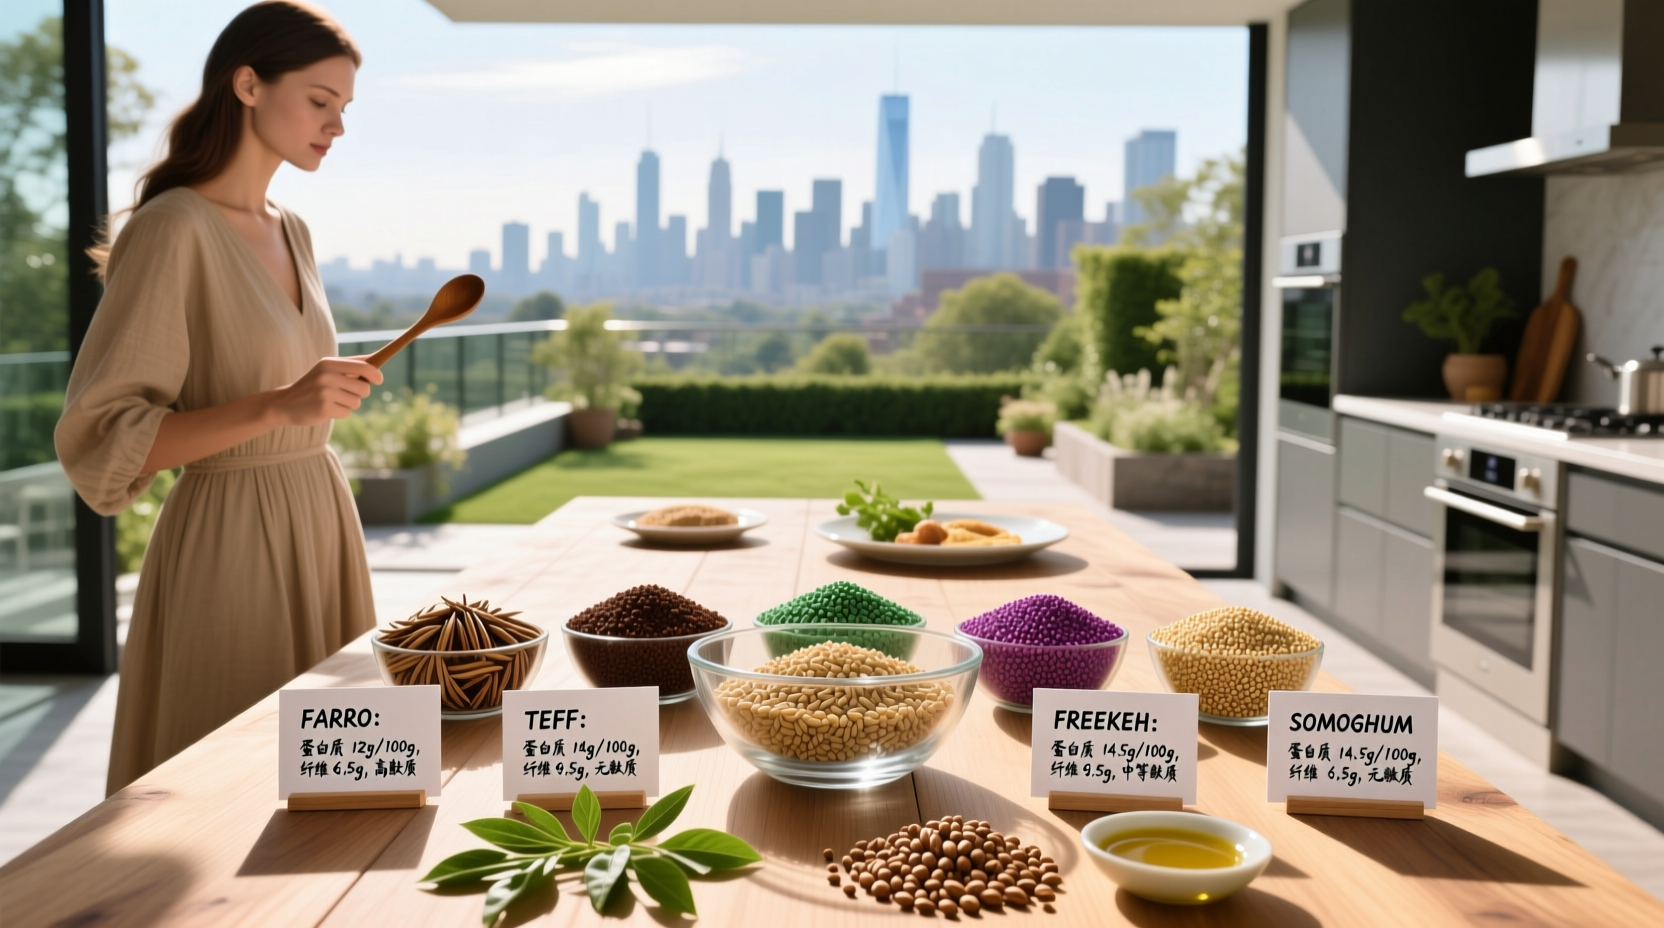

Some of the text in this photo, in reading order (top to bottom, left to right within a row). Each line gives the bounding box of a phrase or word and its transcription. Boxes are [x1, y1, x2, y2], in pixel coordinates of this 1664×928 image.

[301, 708, 380, 729] FARRO:
[525, 709, 586, 730] TEFF:
[1054, 710, 1158, 732] FREEKEH:
[1289, 712, 1413, 734] SOMOGHUM
[300, 738, 344, 757] 蛋白质
[523, 739, 565, 757] 蛋白质
[1051, 739, 1094, 758] 蛋白质
[1288, 742, 1331, 762] 蛋白质
